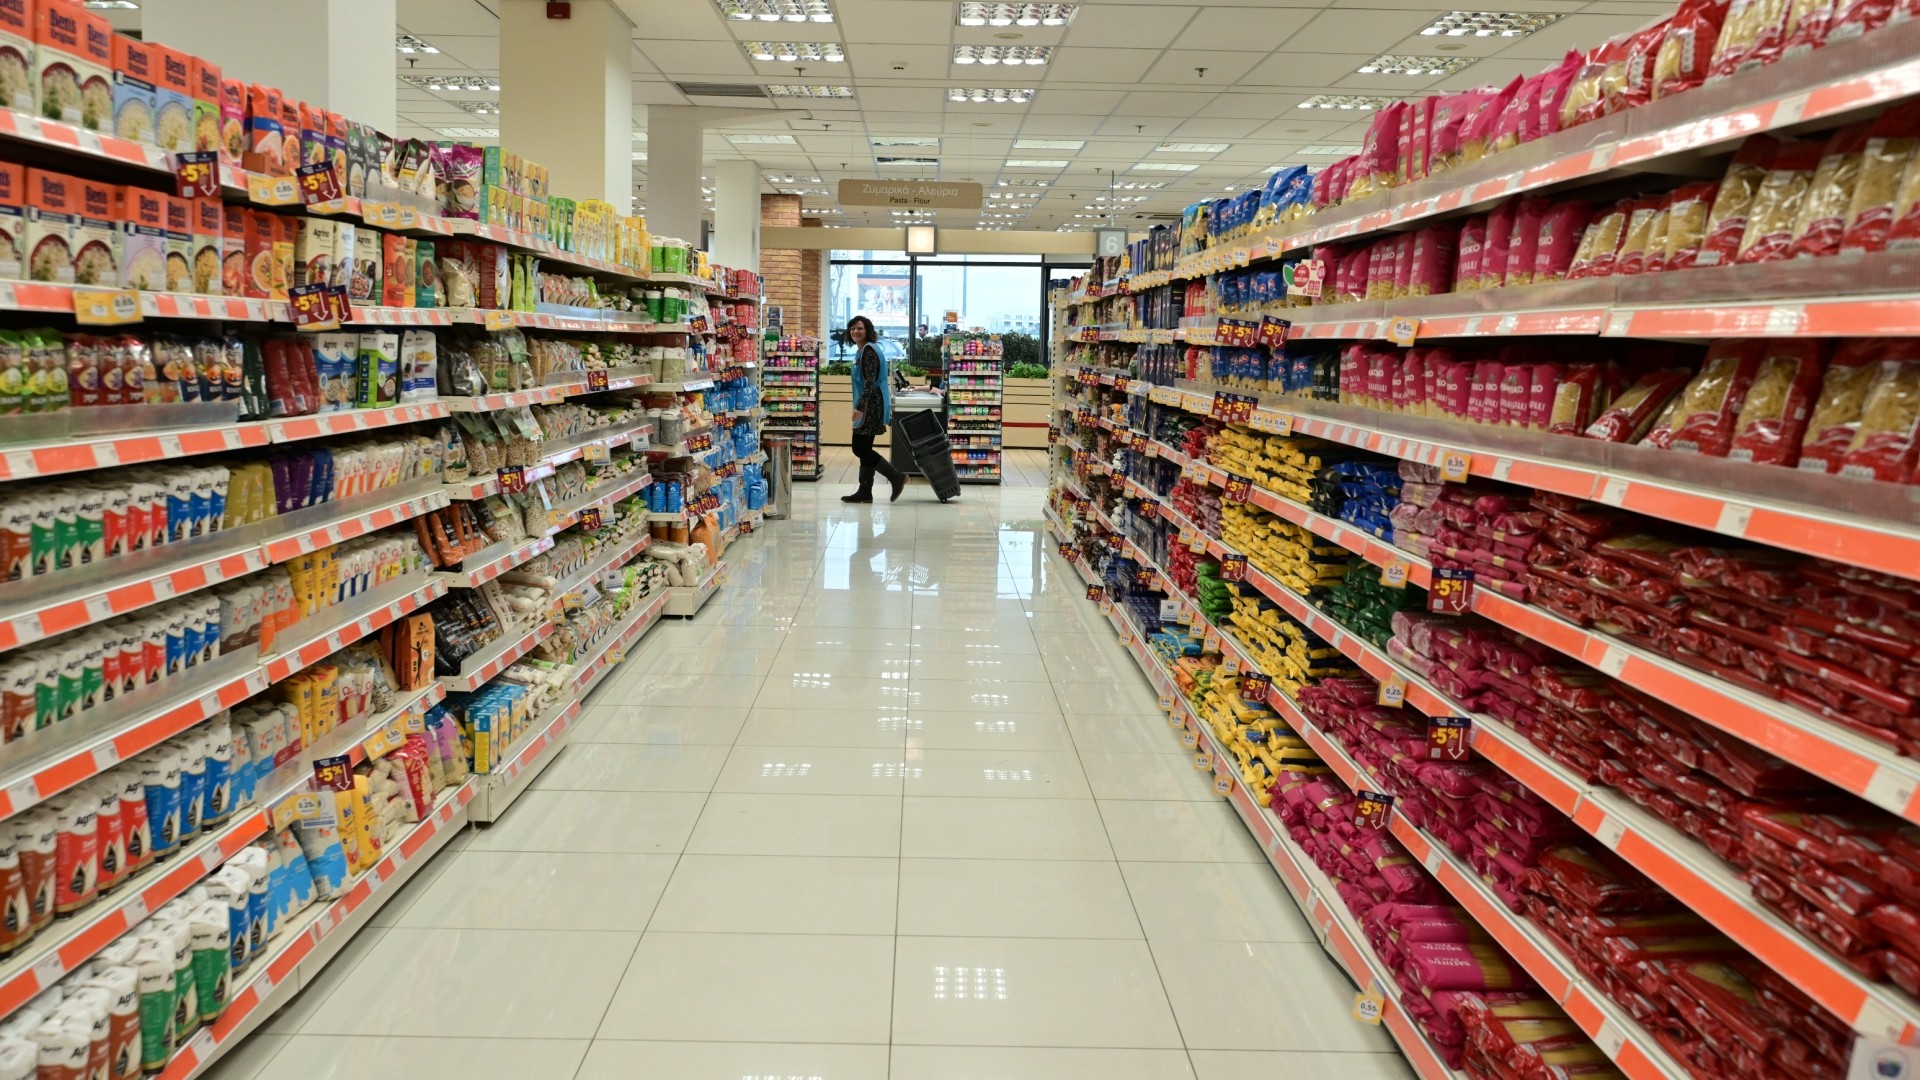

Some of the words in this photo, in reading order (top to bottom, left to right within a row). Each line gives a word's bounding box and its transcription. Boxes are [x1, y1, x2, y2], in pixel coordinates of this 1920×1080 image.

[181, 163, 209, 182] -5%
[303, 172, 328, 190] -5%
[862, 184, 909, 196] Ζυμαρικά
[918, 186, 958, 198] Αλεύρια
[313, 228, 330, 240] Agrino
[357, 235, 372, 246] Agrino
[1106, 236, 1118, 254] 6
[295, 294, 319, 311] -5%
[1235, 327, 1252, 337] -5%
[1264, 324, 1282, 335] -5%
[1234, 402, 1250, 412] -5%
[501, 474, 518, 485] -5%
[1228, 481, 1244, 491] -5%
[582, 514, 595, 523] -5%
[1224, 561, 1241, 573] -5%
[1435, 580, 1462, 596] -5%
[1246, 679, 1263, 690] -5%
[1432, 728, 1458, 744] -5%
[319, 765, 343, 782] -5%
[1358, 800, 1382, 815] -5%
